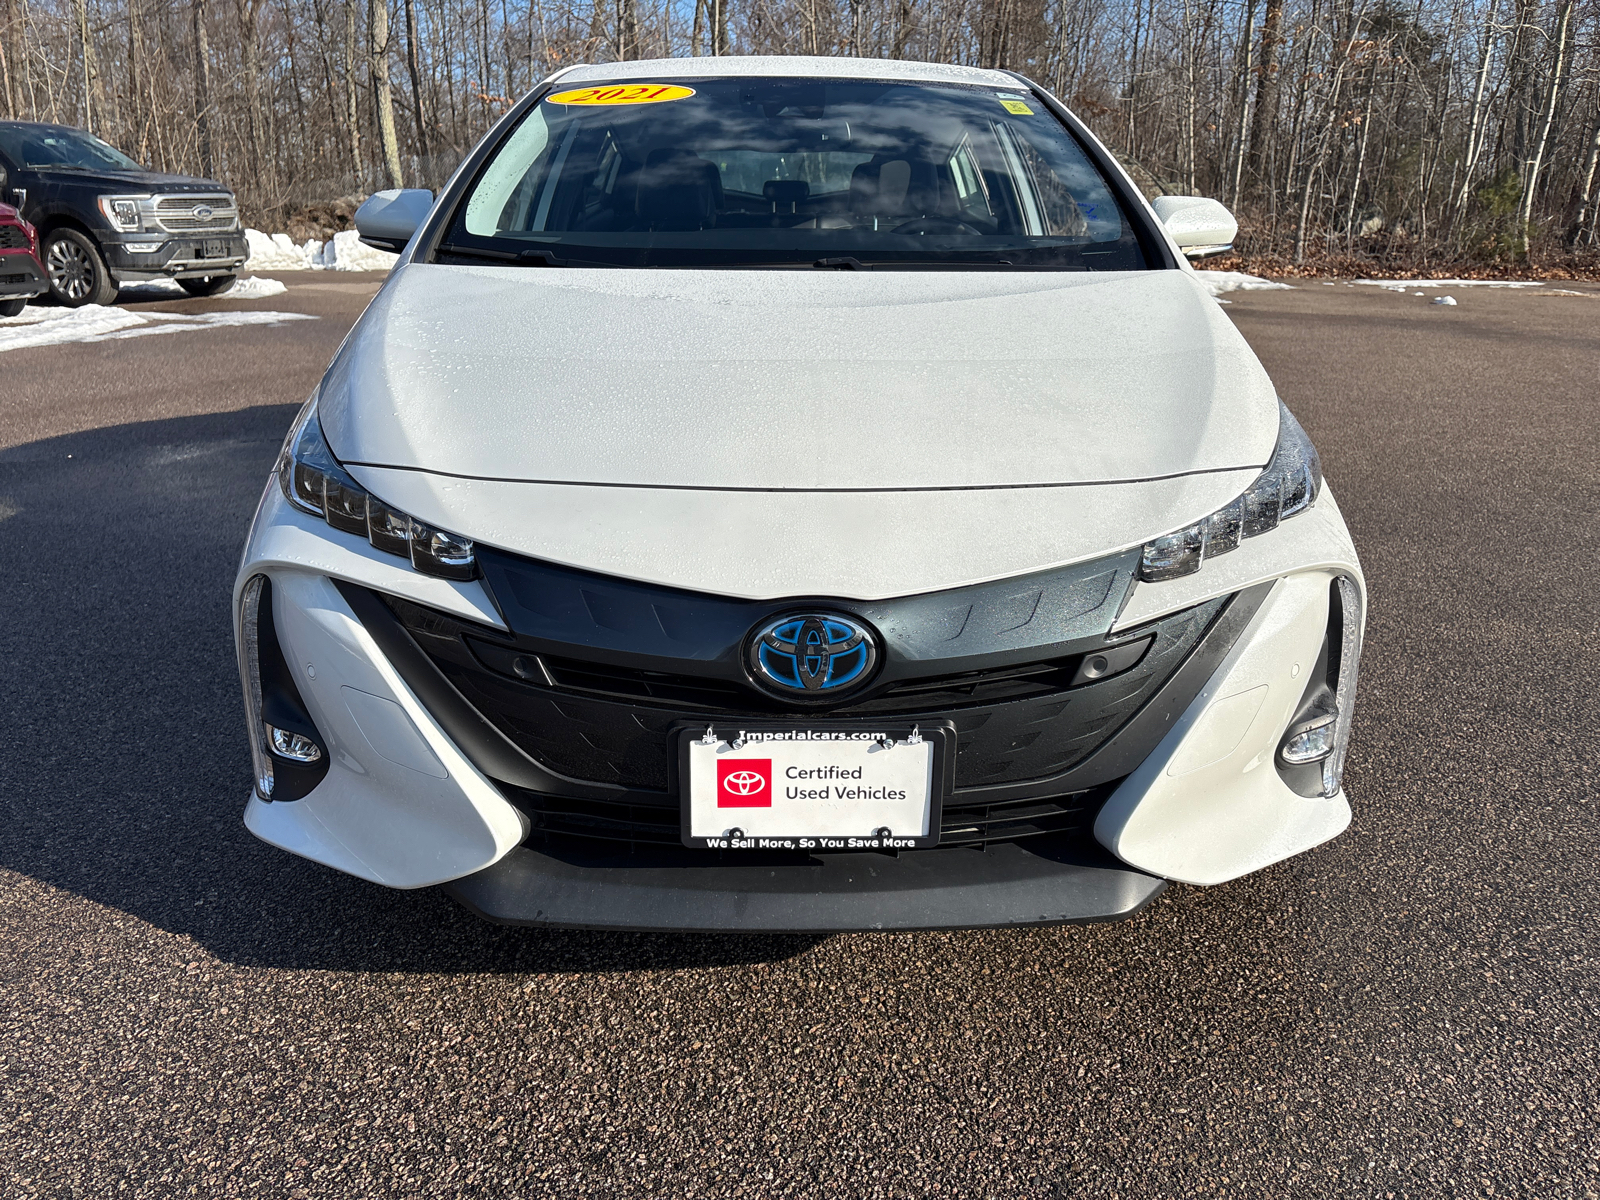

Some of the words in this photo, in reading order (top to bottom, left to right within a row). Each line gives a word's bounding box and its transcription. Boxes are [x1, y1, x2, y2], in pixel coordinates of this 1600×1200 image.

[570, 87, 671, 101] 2021
[738, 730, 887, 741] Imperialcars.com
[785, 766, 862, 780] Certified
[785, 786, 830, 800] Used
[834, 786, 907, 801] Vehicles
[706, 838, 729, 848] We
[731, 838, 755, 848] Sell
[759, 838, 796, 850] More,
[799, 838, 816, 848] So
[820, 838, 844, 848] You
[847, 837, 879, 848] Save
[882, 837, 916, 848] More
